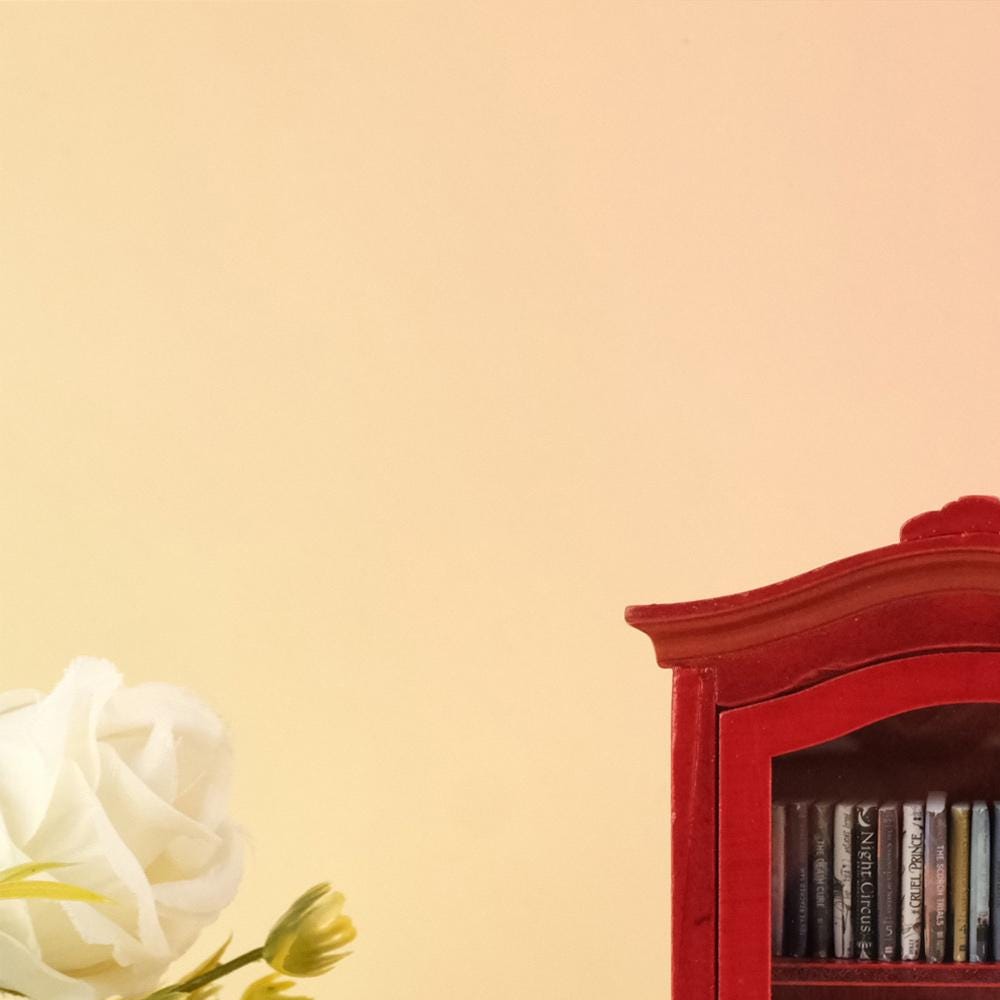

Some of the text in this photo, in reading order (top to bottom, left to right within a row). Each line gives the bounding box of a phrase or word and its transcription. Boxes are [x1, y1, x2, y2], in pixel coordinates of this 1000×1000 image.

[815, 840, 825, 908] THE DEATH CURE
[857, 832, 875, 933] Night Circus
[908, 832, 923, 909] CRUEL PRINCE
[936, 845, 944, 926] THE SCORCH TRIALS
